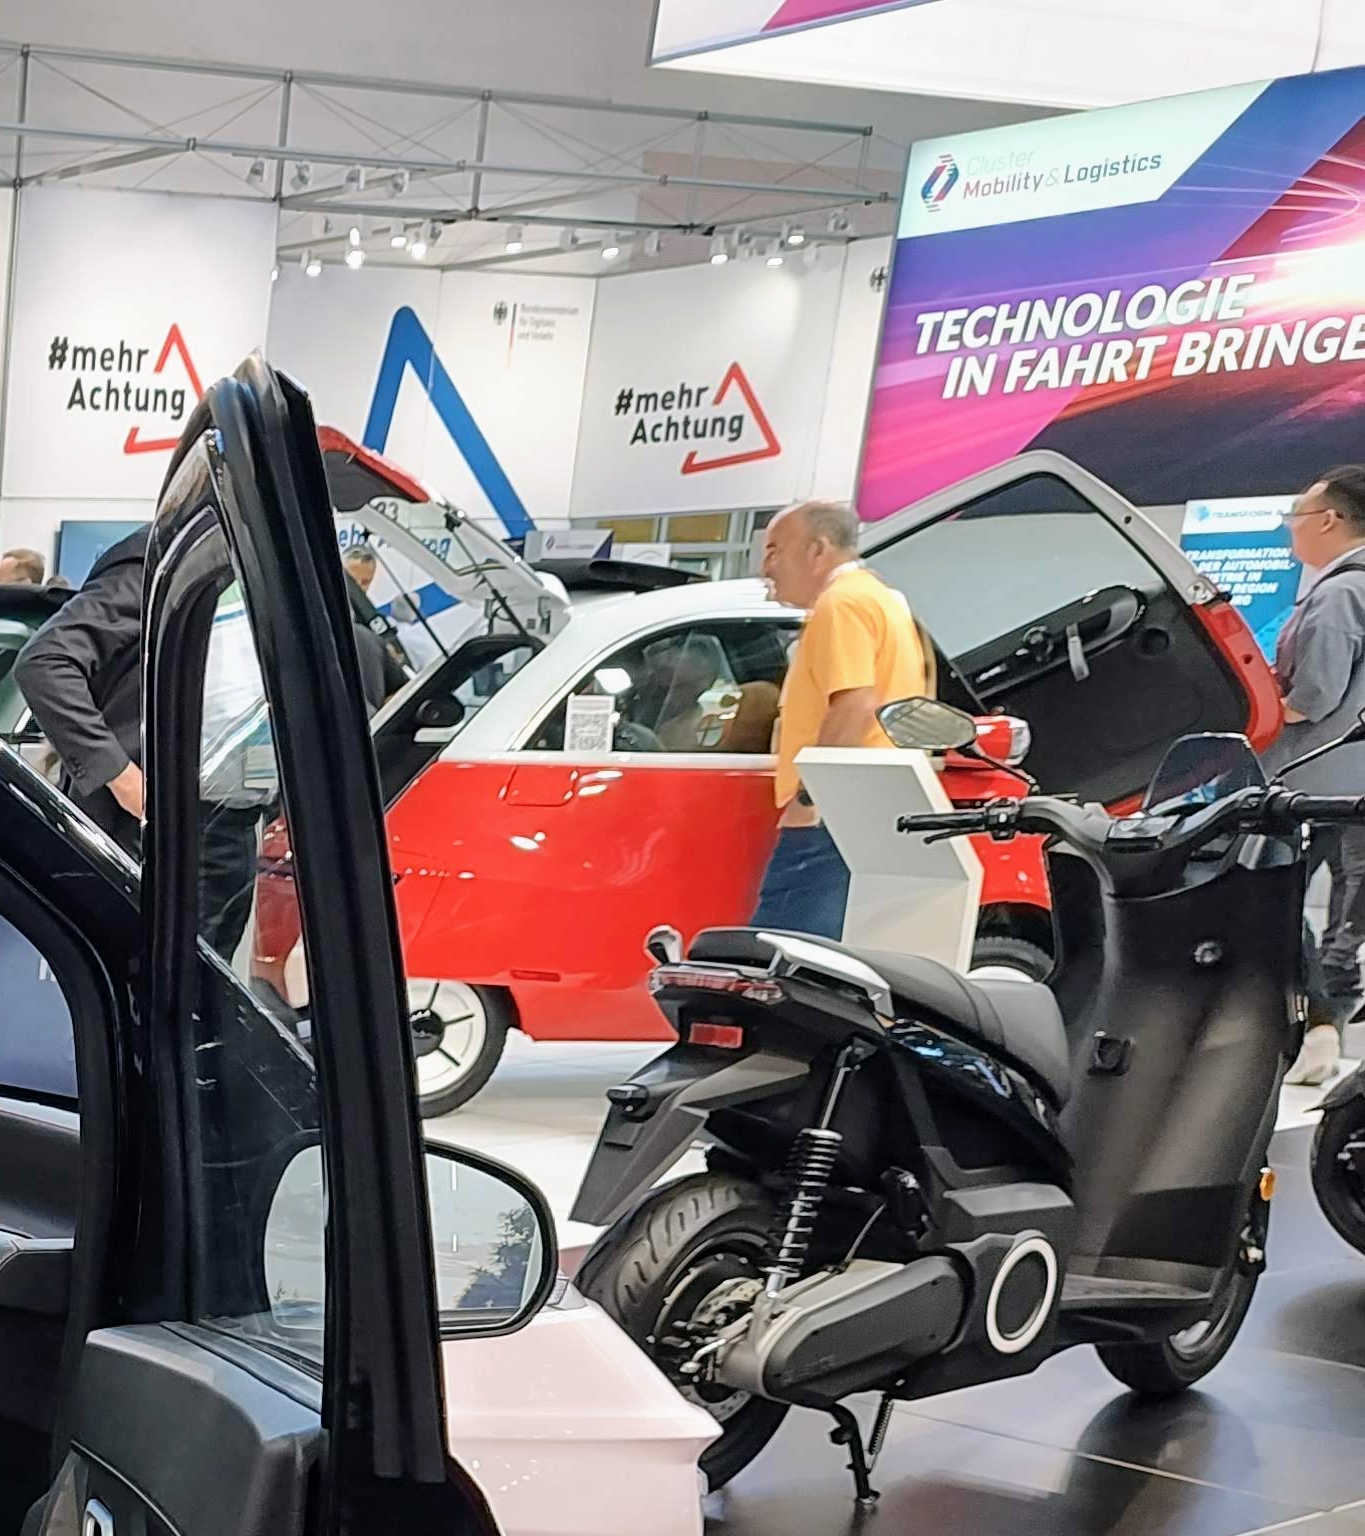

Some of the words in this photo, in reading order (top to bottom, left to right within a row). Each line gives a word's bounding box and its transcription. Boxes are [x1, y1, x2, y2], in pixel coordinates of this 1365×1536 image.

[963, 171, 1045, 200] Mobility
[1064, 154, 1163, 184] Logistics
[967, 150, 1037, 177] Cluster
[916, 273, 1256, 355] TECHNOLOGIE
[48, 335, 149, 373] #mehr
[942, 353, 999, 400] IN
[1003, 335, 1170, 394] FAHRT
[1171, 315, 1365, 378] BRINGE
[67, 377, 186, 421] Achtung
[614, 382, 709, 416] #mehr
[629, 413, 745, 446] Achtung
